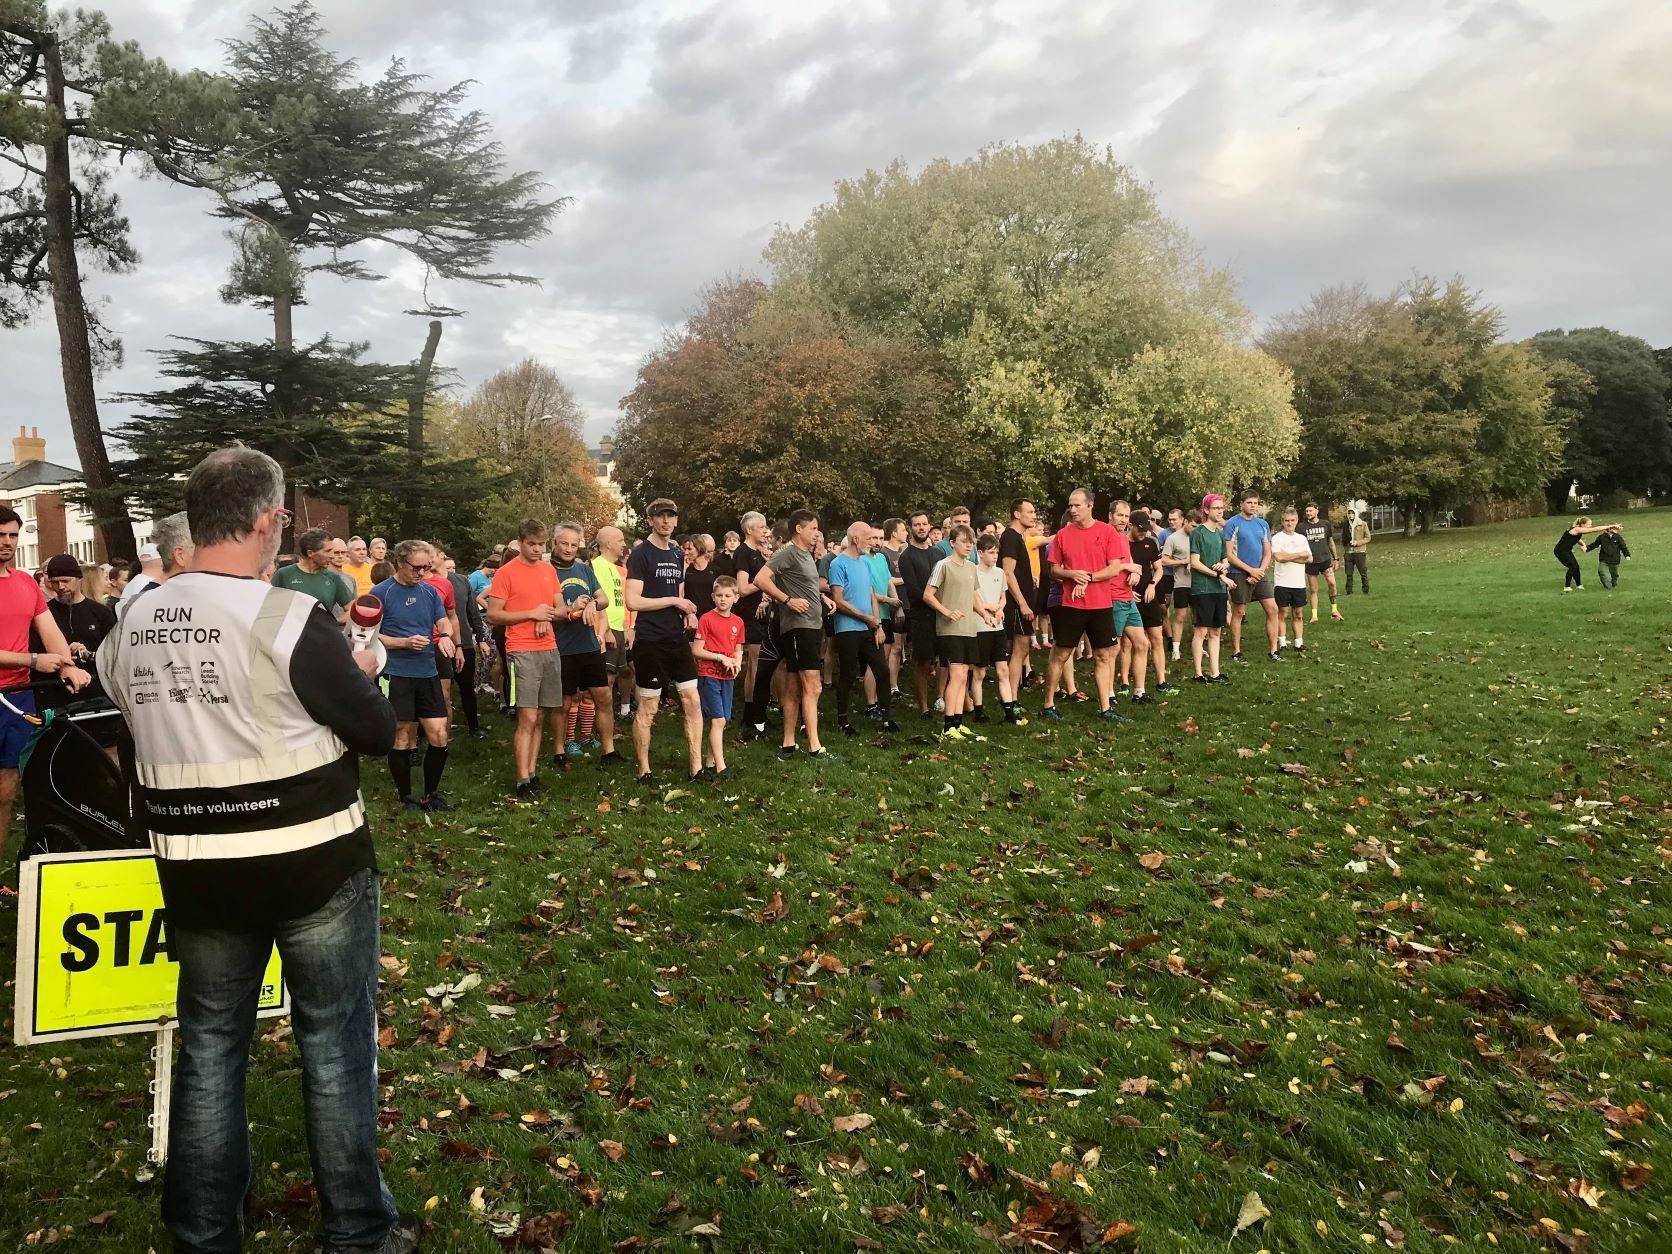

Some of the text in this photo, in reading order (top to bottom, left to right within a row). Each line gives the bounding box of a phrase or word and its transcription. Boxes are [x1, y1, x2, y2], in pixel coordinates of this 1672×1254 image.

[153, 607, 193, 623] RUN
[130, 628, 221, 647] DIRECTOR
[168, 805, 181, 816] to
[183, 803, 204, 815] the
[206, 798, 280, 814] volunteers
[80, 803, 125, 833] BURLEY
[60, 907, 180, 973] STA
